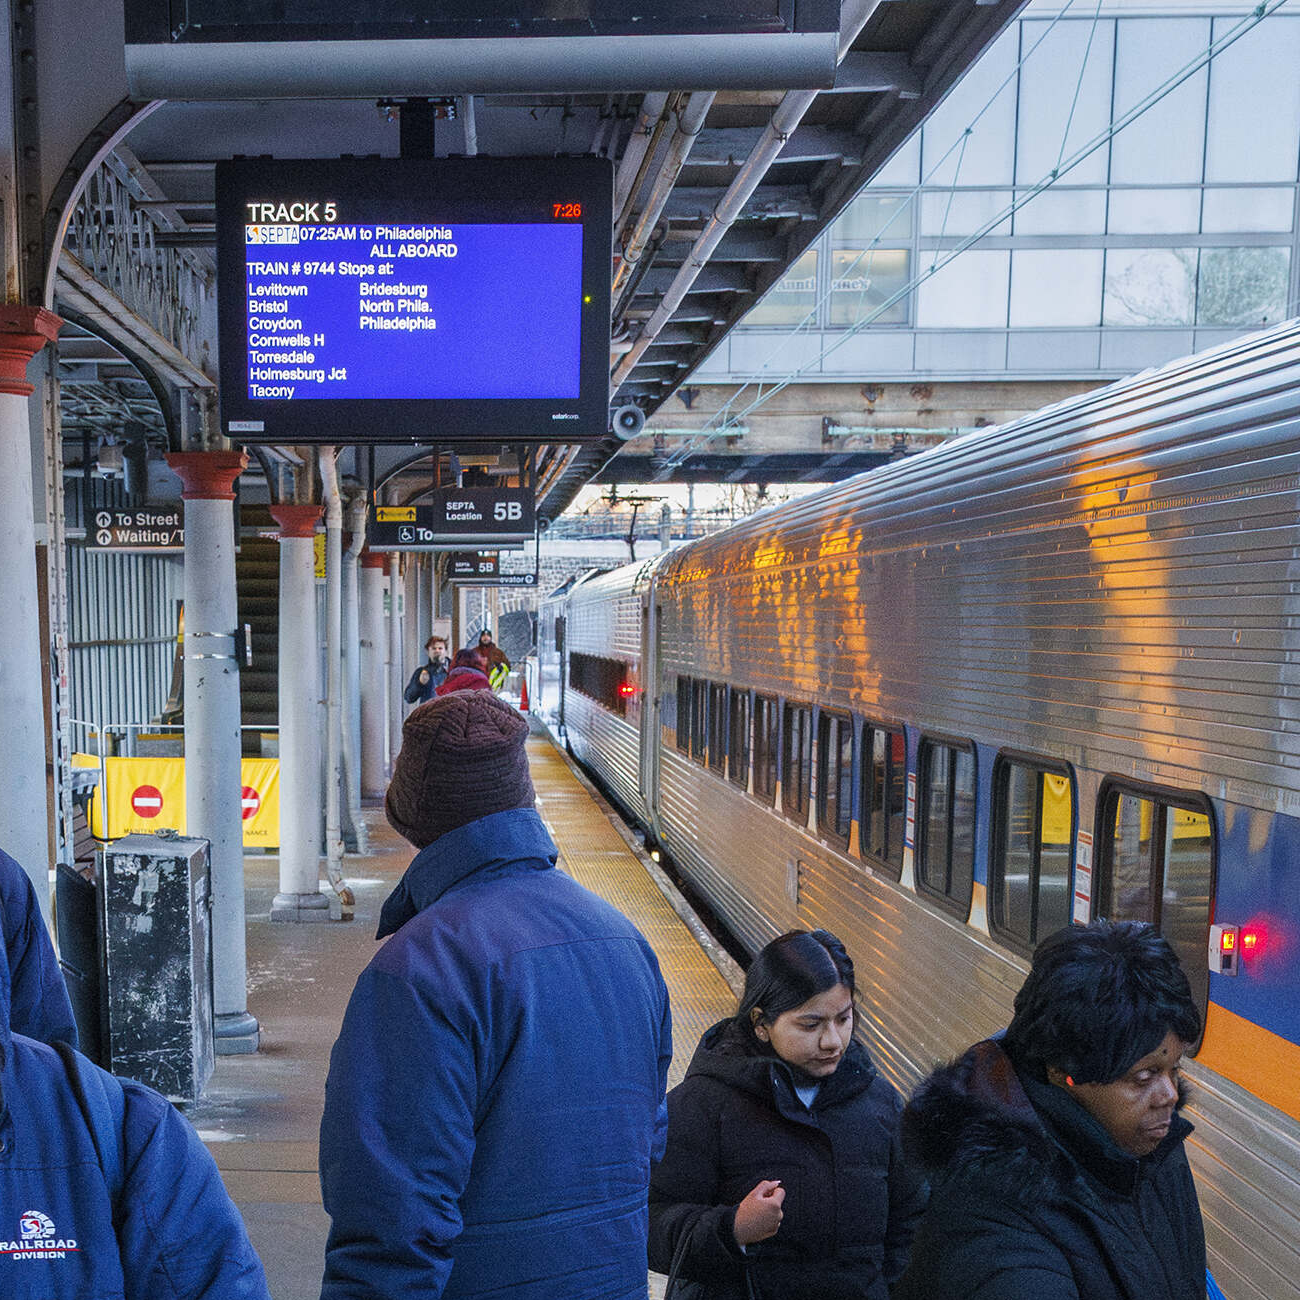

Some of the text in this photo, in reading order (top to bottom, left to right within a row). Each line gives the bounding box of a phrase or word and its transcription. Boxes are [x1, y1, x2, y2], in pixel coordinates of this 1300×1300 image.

[247, 203, 337, 222] TRACK 5
[553, 204, 582, 217] 7:26
[261, 227, 452, 243] SEPTA 07:25AM to Philadelphia
[370, 244, 458, 258] ALL ABOARD
[247, 262, 394, 278] TRAIN # 9744 Stops at:
[249, 283, 308, 296] Levittown
[360, 283, 428, 298] Bridesburg
[249, 300, 288, 313] Bristol
[360, 300, 432, 312] North Phila.
[249, 317, 302, 333] Croydon
[360, 316, 436, 332] Philadelphia
[249, 334, 324, 347] Cornwells H
[250, 351, 315, 364] Torresdale
[250, 368, 346, 383] Holmesburg Jct
[250, 385, 294, 400] Tacony
[446, 502, 475, 510] SEPTA
[494, 502, 522, 521] 5B
[116, 512, 179, 526] To Street
[446, 512, 482, 520] Location
[416, 528, 434, 540] To
[478, 562, 494, 572] 5B
[13, 1252, 66, 1260] DIVISION
